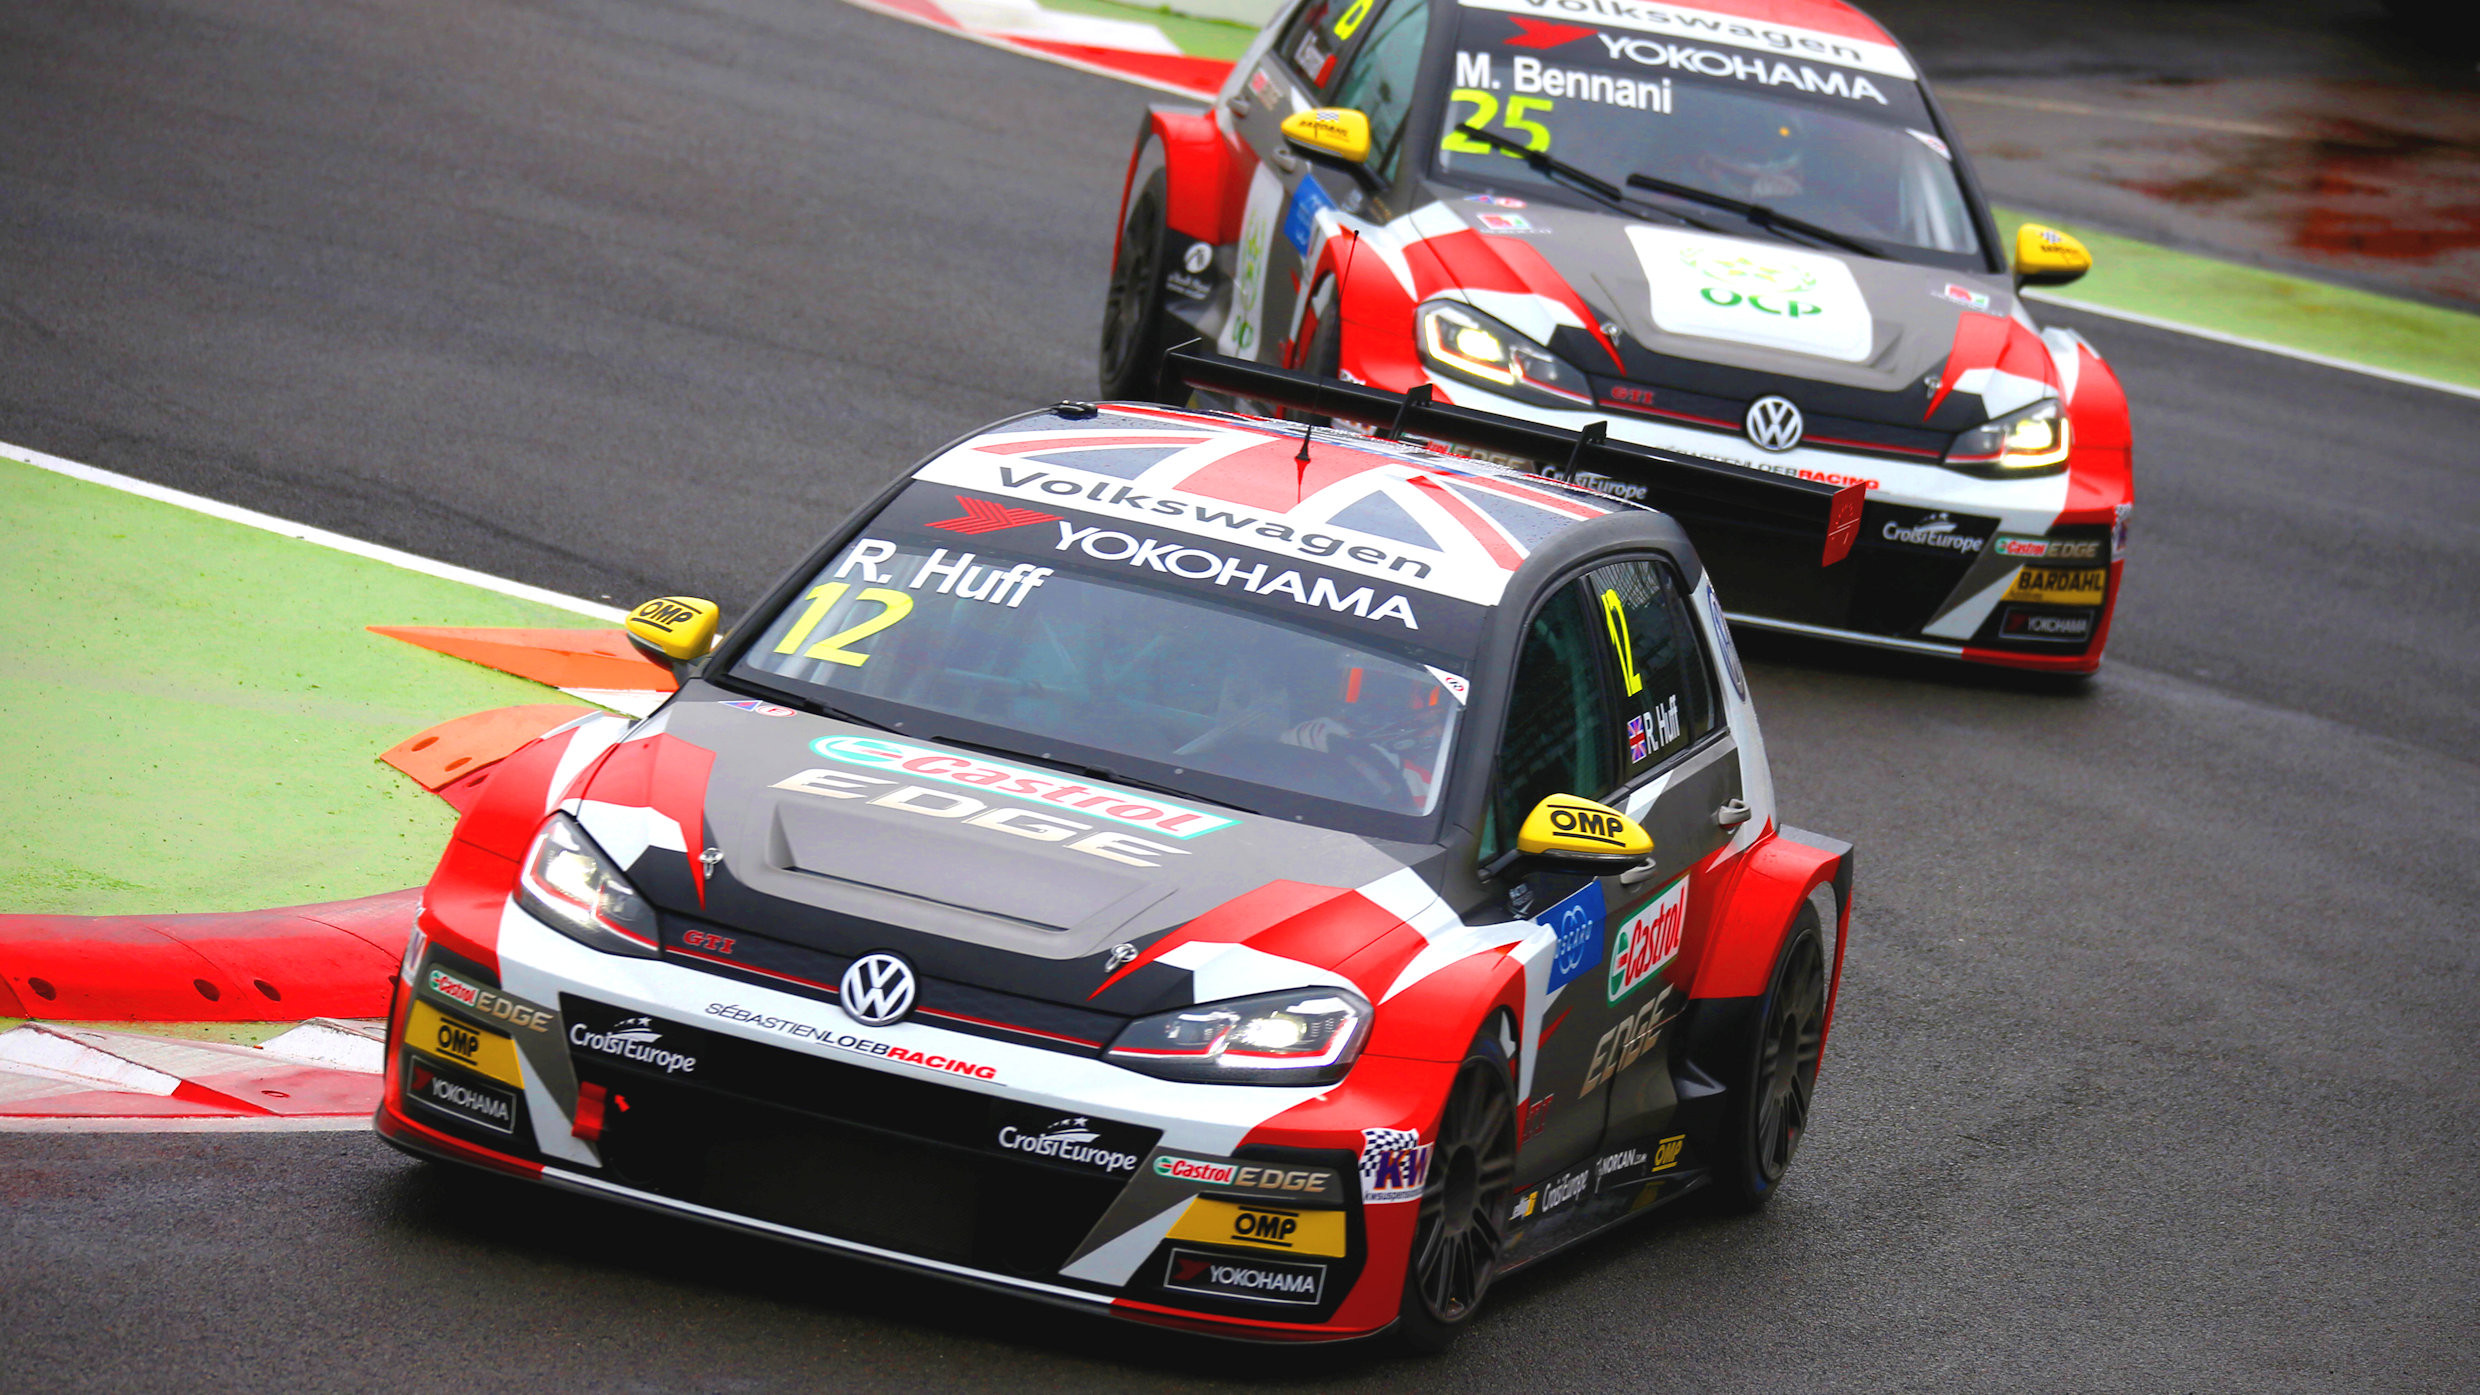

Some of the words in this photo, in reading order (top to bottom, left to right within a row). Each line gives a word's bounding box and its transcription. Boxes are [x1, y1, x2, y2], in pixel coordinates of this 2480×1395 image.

[1456, 51, 1501, 90] M.
[1513, 55, 1673, 114] Bennani
[1597, 33, 1888, 106] YOKOHAMA
[1441, 89, 1554, 159] 25
[1611, 386, 1655, 404] GTI
[998, 466, 1433, 580] Volkswagen
[1883, 520, 1984, 554] CroisiEurope
[833, 538, 897, 585] R.
[908, 547, 1054, 608] Huff
[2047, 542, 2099, 558] EDGE
[1049, 520, 1420, 631] YOKOHAMA
[2018, 571, 2103, 591] BARDAHL
[640, 601, 694, 625] OMP
[773, 581, 914, 668] 12
[1601, 588, 1643, 697] 12
[1655, 694, 1680, 747] Huff
[900, 754, 1205, 833] Castrol
[768, 768, 1192, 868] EDGE
[1550, 810, 1623, 838] OMP
[683, 929, 737, 955] GTI
[1624, 885, 1686, 987] Castrol
[475, 990, 554, 1033] EDGE
[437, 1025, 479, 1058] OMP
[569, 1021, 697, 1074] CroisiEurope
[1577, 981, 1676, 1099] EDGE
[431, 1076, 510, 1121] YOKOHAMA
[999, 1124, 1137, 1173] CroisiEurope
[1373, 1147, 1430, 1191] KW
[1655, 1140, 1683, 1167] OMP
[1171, 1160, 1234, 1184] Castrol
[1234, 1166, 1332, 1193] EDGE
[1235, 1213, 1296, 1240] OMP
[1210, 1265, 1315, 1294] YOKOHAMA
